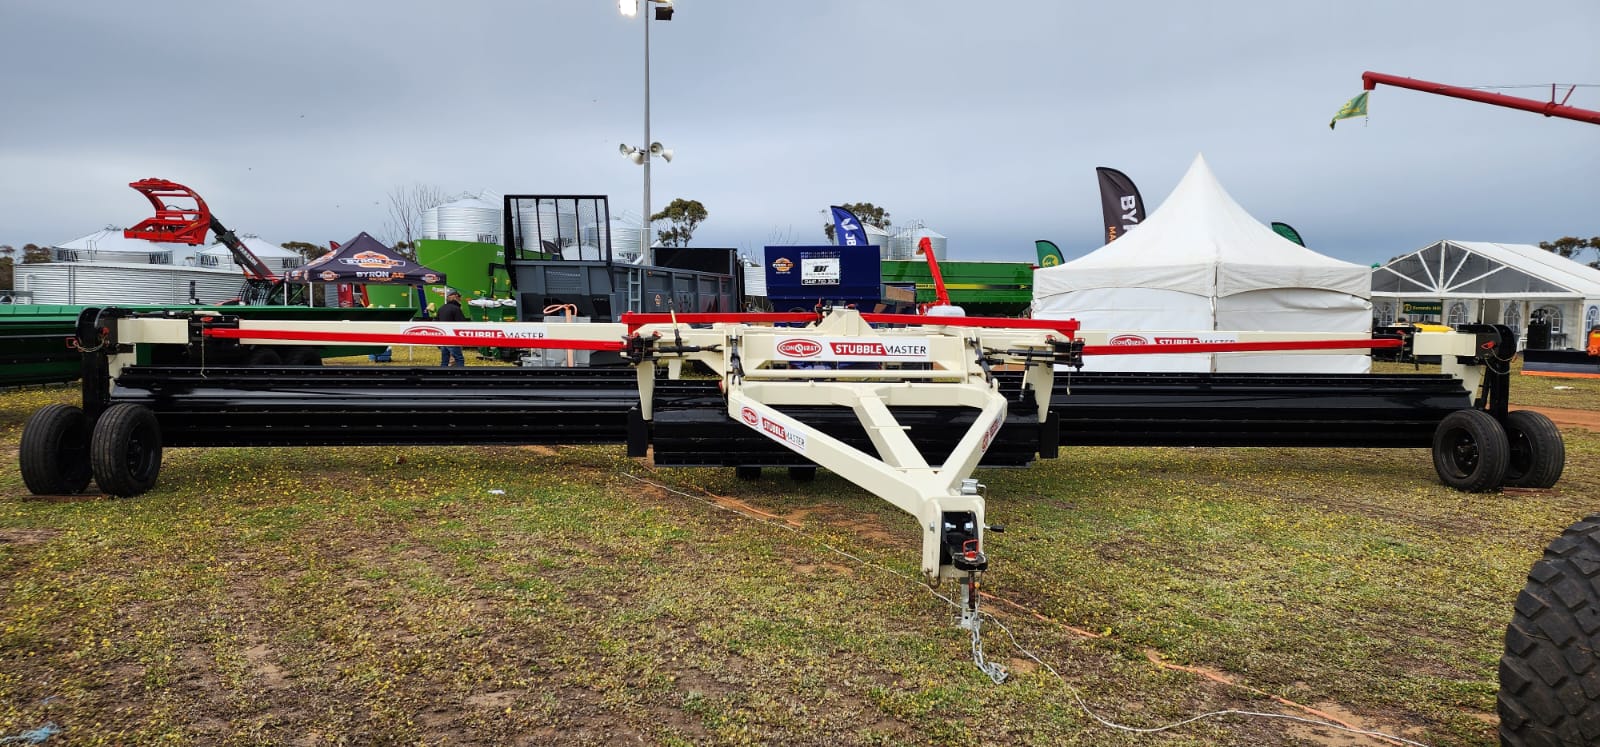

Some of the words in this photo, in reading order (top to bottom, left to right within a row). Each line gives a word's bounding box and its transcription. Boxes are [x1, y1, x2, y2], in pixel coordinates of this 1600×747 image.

[355, 271, 389, 279] BYRON
[781, 343, 819, 355] CONQUEST
[835, 343, 882, 354] STUBBLE
[884, 345, 927, 354] MASTER
